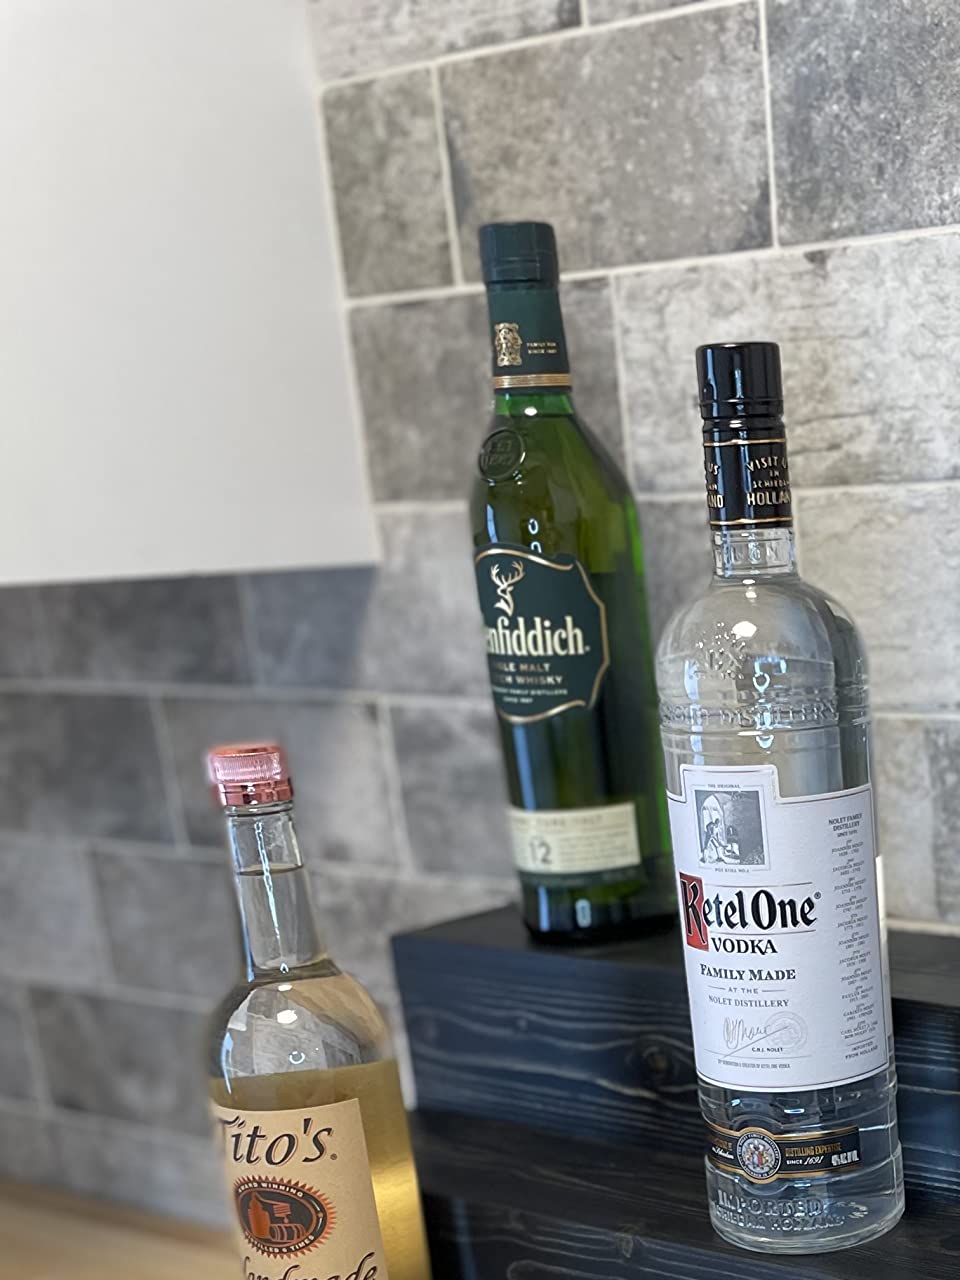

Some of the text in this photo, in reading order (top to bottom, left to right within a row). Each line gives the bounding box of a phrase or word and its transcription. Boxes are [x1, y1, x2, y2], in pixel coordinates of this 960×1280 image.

[746, 455, 779, 472] VISIT
[769, 470, 780, 478] IN
[486, 616, 586, 656] nfiddich
[519, 663, 551, 672] MALT
[515, 676, 563, 685] WHISKY
[530, 839, 554, 865] 12
[679, 878, 749, 945] Ketel
[711, 937, 778, 955] VODKA
[700, 963, 796, 980] FAMILY MADE
[708, 995, 790, 1008] NOLET DISTILLERY
[260, 1182, 304, 1198] WINNING
[289, 1235, 315, 1251] TIMES
